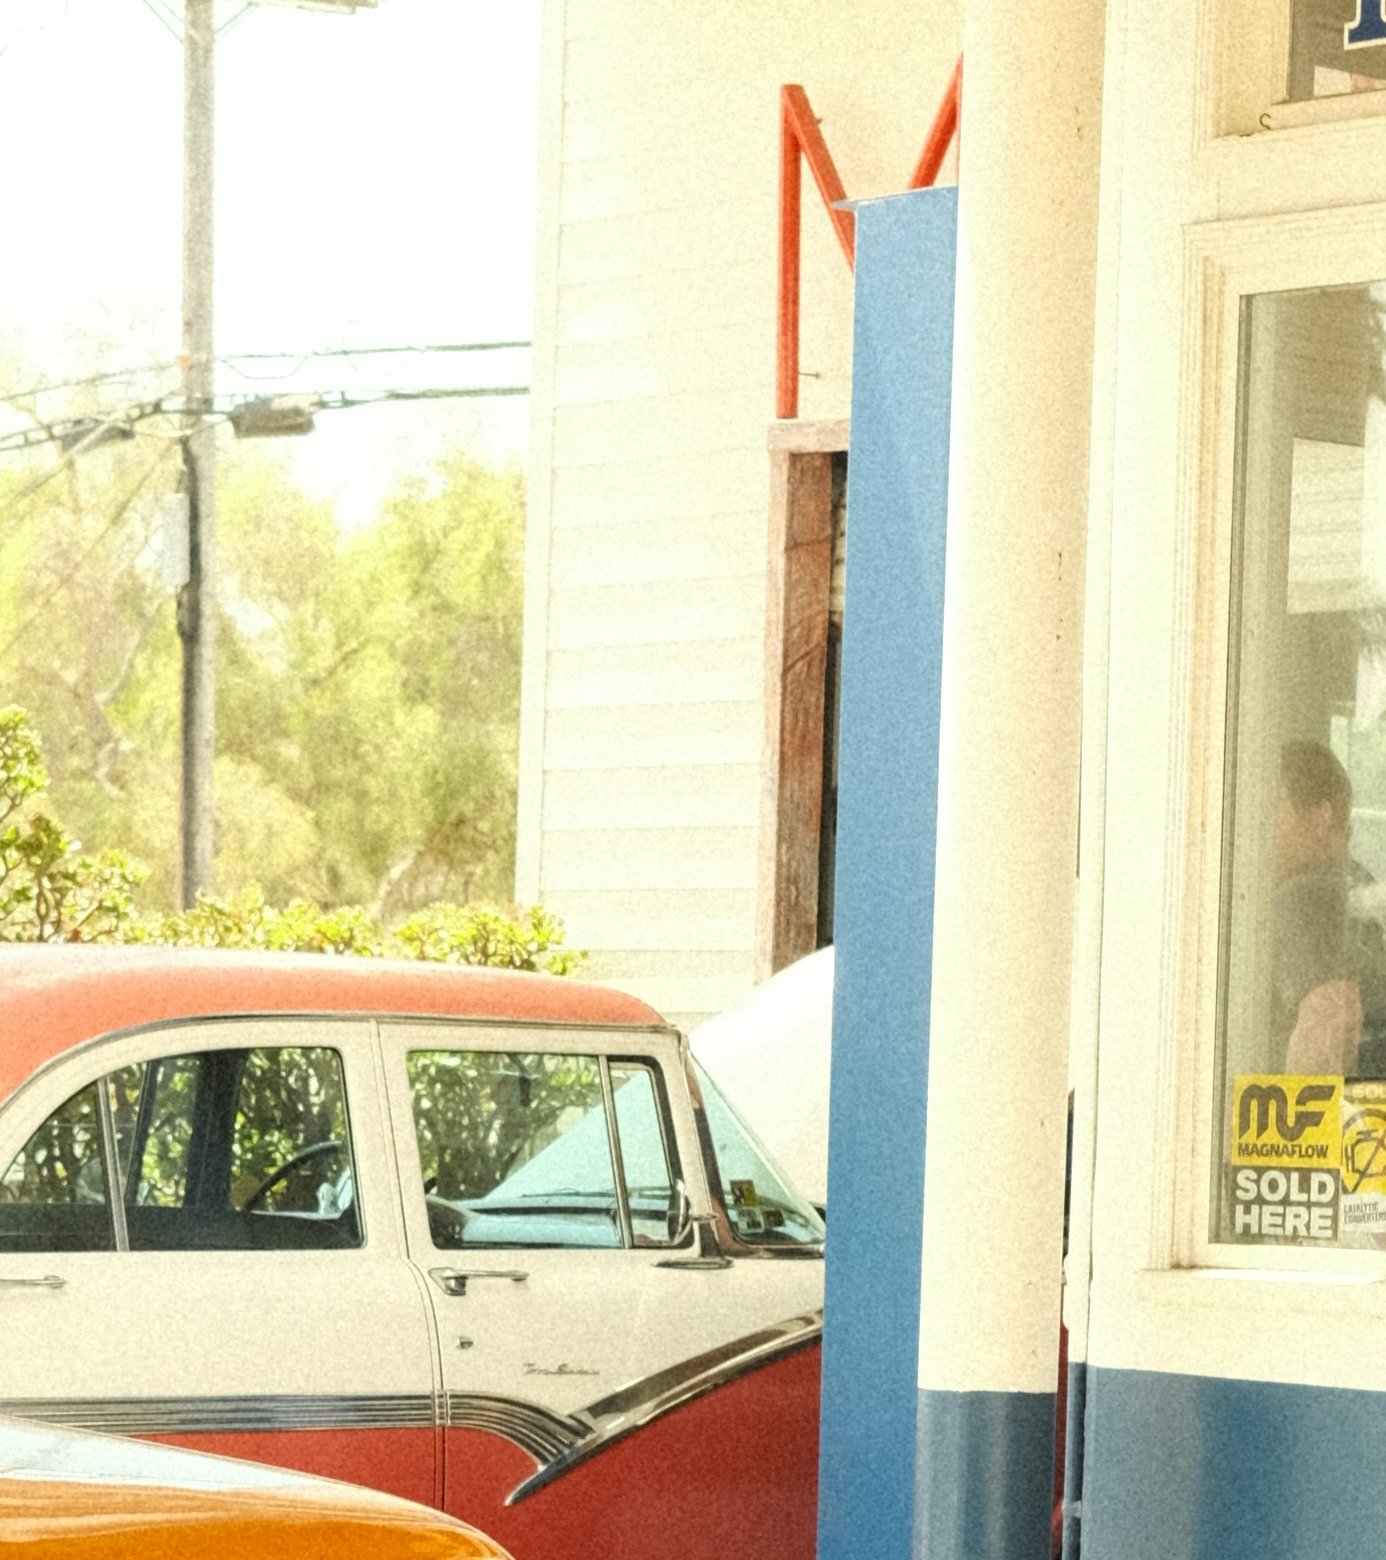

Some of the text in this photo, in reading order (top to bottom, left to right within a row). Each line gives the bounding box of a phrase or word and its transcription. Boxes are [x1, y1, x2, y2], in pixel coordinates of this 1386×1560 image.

[1237, 1143, 1329, 1159] MAGNAFLOW
[1235, 1169, 1336, 1202] SOLD
[1235, 1204, 1334, 1237] HERE
